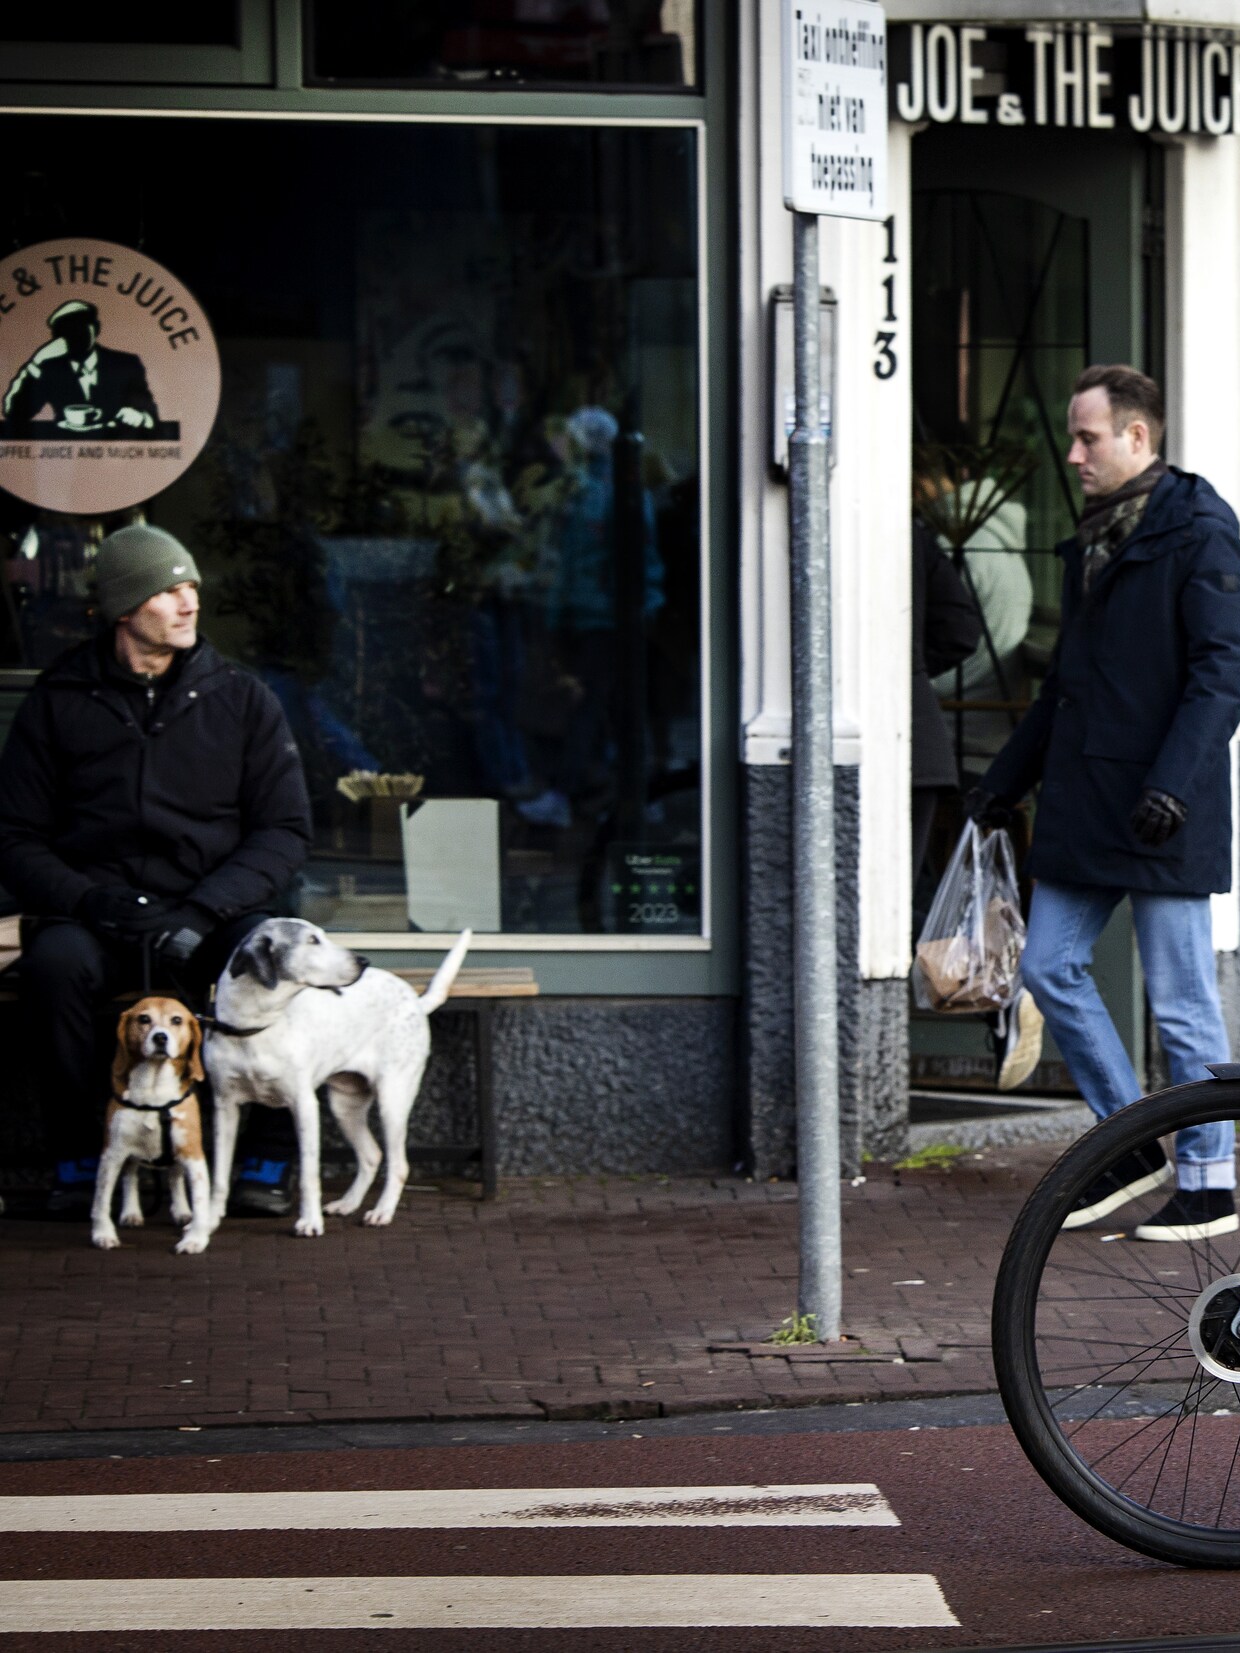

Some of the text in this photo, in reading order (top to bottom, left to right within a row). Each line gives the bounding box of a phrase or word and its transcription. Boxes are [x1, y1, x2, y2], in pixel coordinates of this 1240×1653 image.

[797, 9, 884, 87] Taxi ontheffing
[896, 23, 988, 125] JOE
[997, 93, 1025, 126] &
[1026, 25, 1114, 129] THE
[818, 82, 866, 134] niet van
[811, 142, 874, 209] toepassing
[12, 267, 42, 296] &
[45, 254, 113, 288] THE
[116, 271, 200, 350] JUICE
[40, 446, 72, 459] JUICE
[78, 446, 103, 460] AND
[107, 446, 144, 460] MUCH
[148, 446, 181, 460] MORE
[629, 902, 679, 924] 2023
